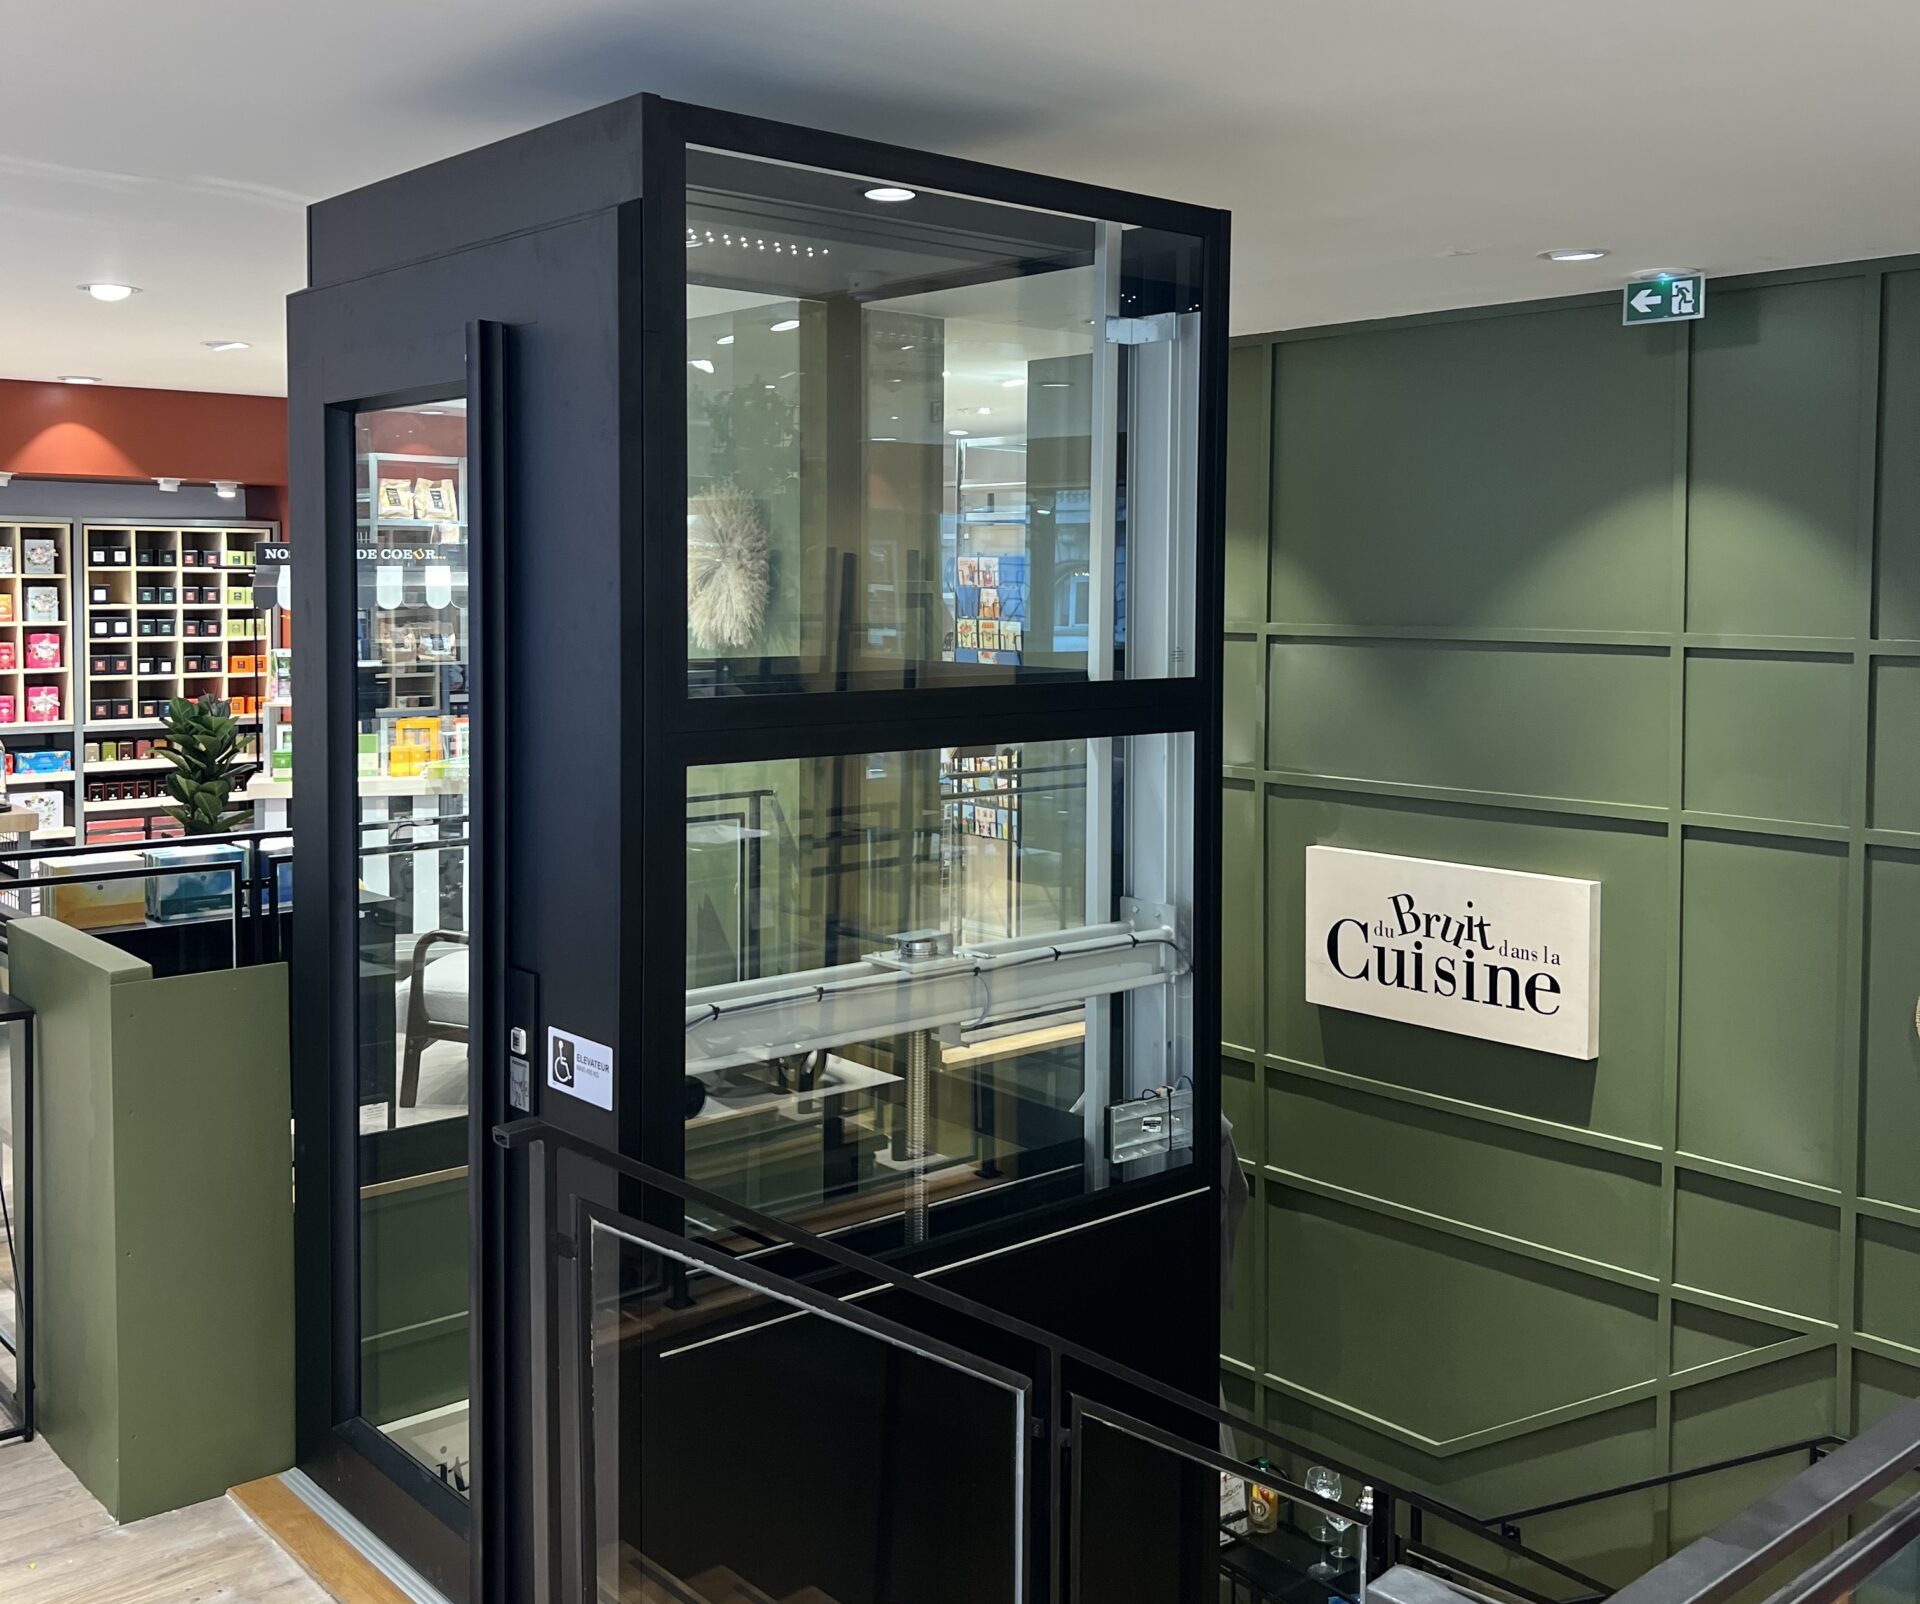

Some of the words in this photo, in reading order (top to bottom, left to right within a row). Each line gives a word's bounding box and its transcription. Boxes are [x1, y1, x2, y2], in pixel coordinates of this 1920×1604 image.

[264, 548, 290, 559] NO
[356, 549, 377, 560] DE
[1373, 919, 1395, 939] du
[1387, 892, 1496, 951] Bruit
[1498, 939, 1539, 962] dans
[1543, 945, 1561, 966] la
[1326, 917, 1562, 1016] Cuisine
[576, 1053, 610, 1074] ELEVATEUR
